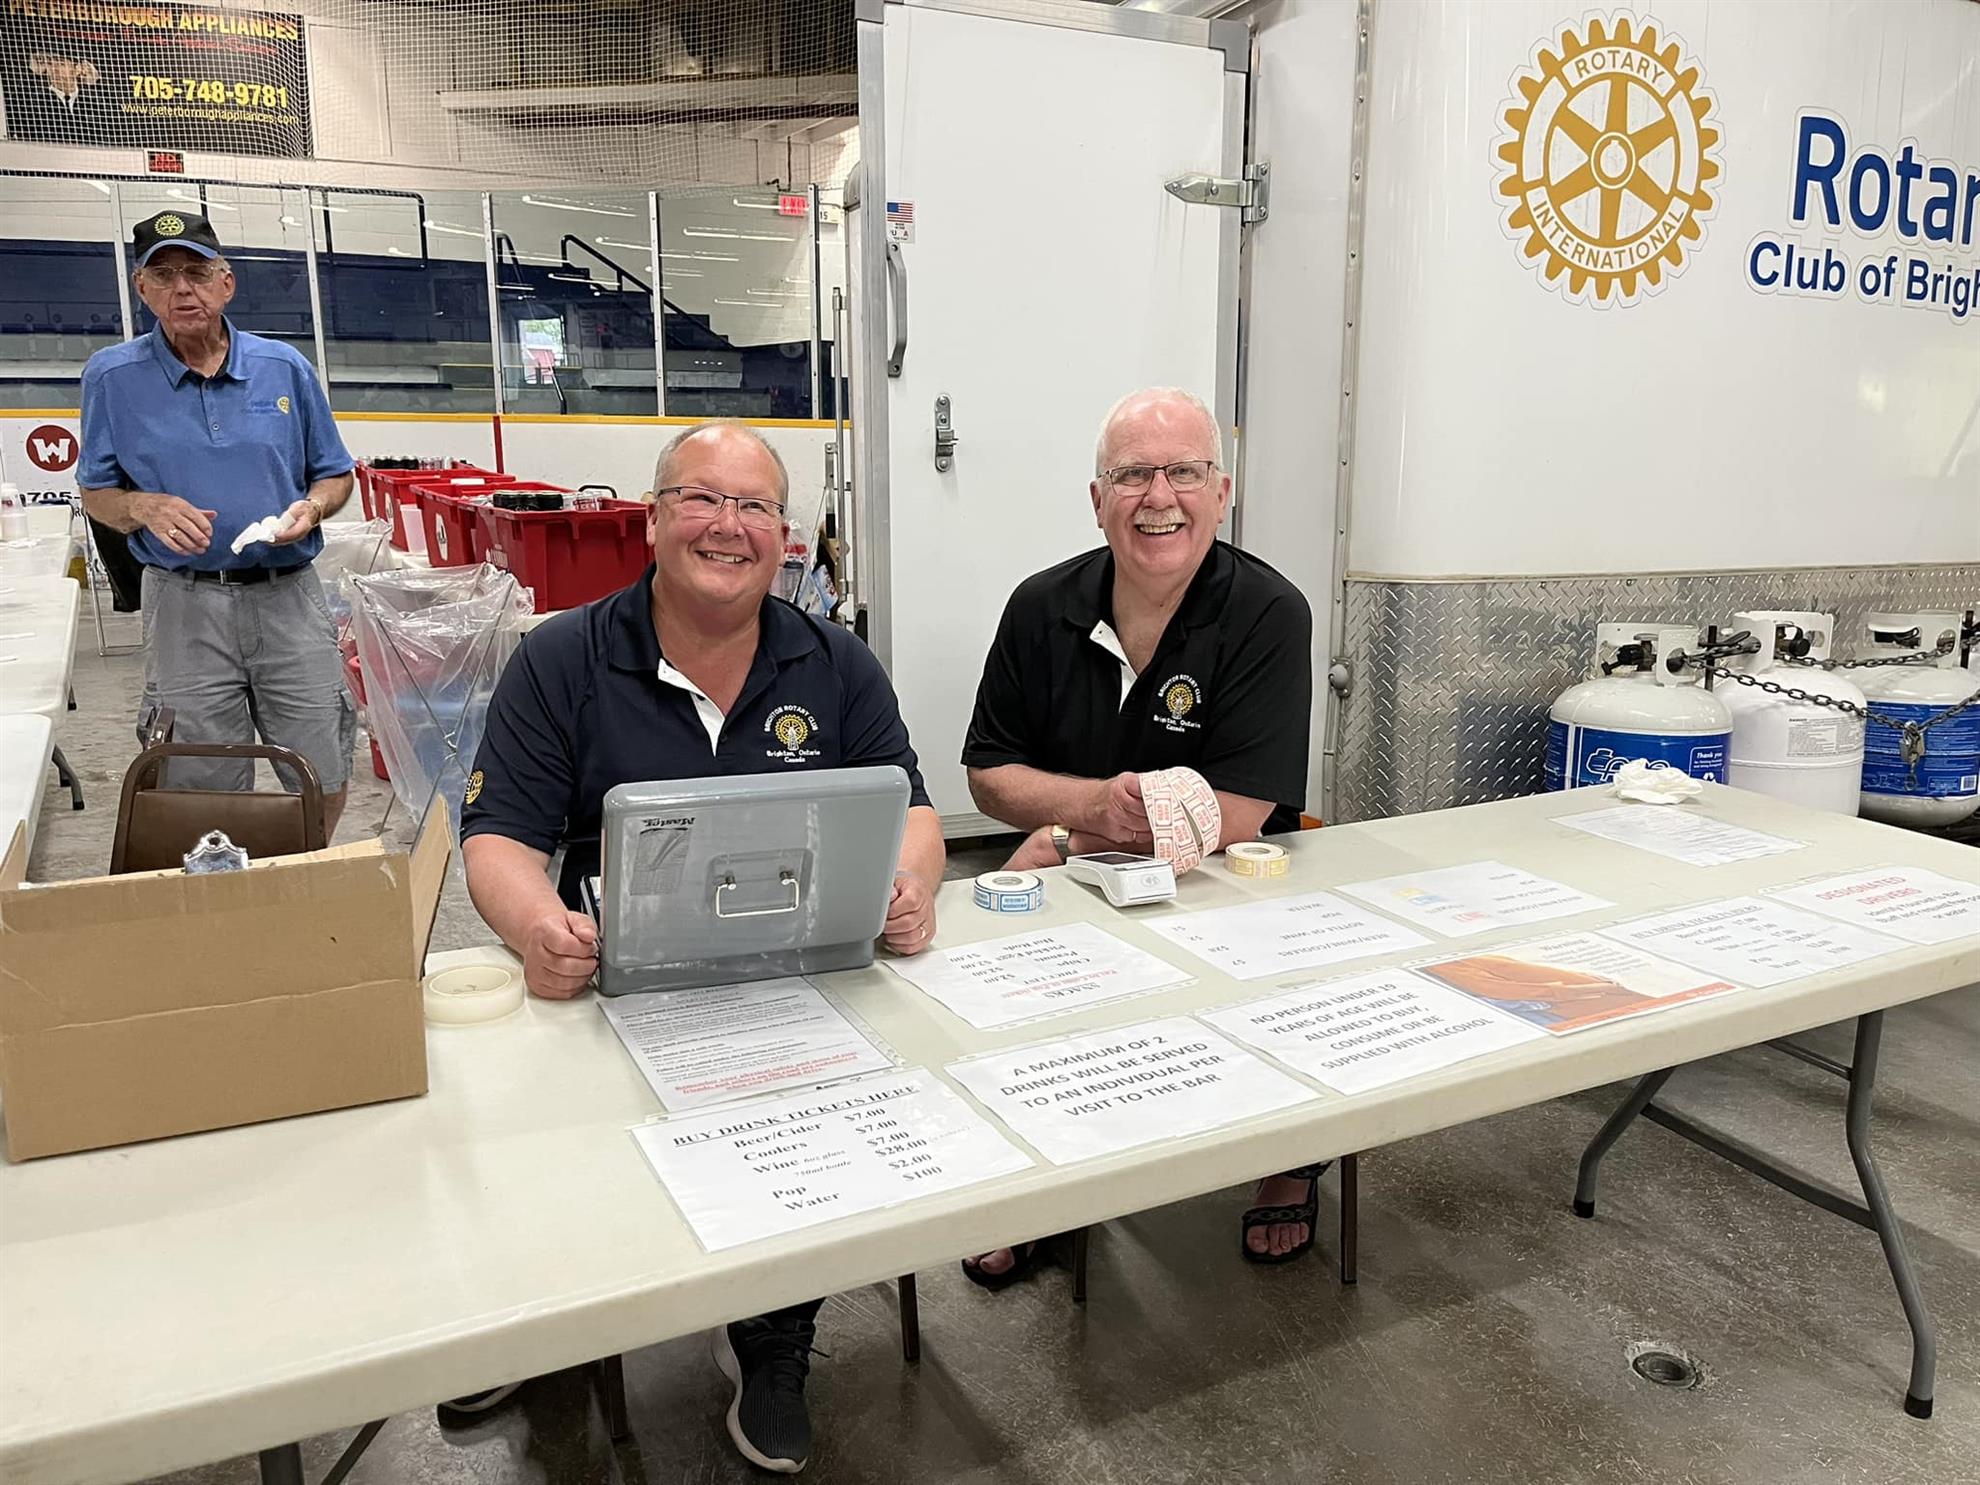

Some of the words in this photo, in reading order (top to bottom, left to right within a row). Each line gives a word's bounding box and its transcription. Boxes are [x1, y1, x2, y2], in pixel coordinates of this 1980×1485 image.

[179, 10, 299, 40] APPLIANCES
[1575, 50, 1665, 86] ROTARY
[129, 75, 289, 109] 705-748-9781
[1531, 200, 1685, 271] INTERNATIONAL
[1750, 241, 1847, 294] Club
[1860, 255, 1899, 299] of
[32, 438, 71, 463] W
[783, 705, 810, 717] ROTARY
[1041, 981, 1102, 999] SNACKS
[1250, 1013, 1275, 1026] NO
[1274, 998, 1332, 1020] PERSON
[1330, 987, 1383, 1008] UNDER
[1381, 982, 1398, 993] 19
[1268, 1018, 1315, 1036] YEARS
[1316, 1012, 1335, 1024] OF
[1336, 1004, 1367, 1020] AGE
[1366, 996, 1400, 1013] WILL
[1398, 991, 1420, 1003] BE
[1303, 1019, 1373, 1044] ALLOWED
[1373, 1012, 1393, 1024] TO
[1394, 1003, 1430, 1021] BUY,
[1329, 1028, 1400, 1052] CONSUME
[1401, 1020, 1423, 1033] OR
[1423, 1014, 1446, 1027] BE
[1013, 1062, 1029, 1077] A
[1029, 1045, 1127, 1073] MAXIMUM
[1127, 1037, 1152, 1051] OF
[1153, 1035, 1169, 1045] 2
[1321, 1046, 1391, 1071] SUPPLIED
[1390, 1033, 1431, 1052] WITH
[1430, 1016, 1495, 1041] ALCOHOL
[1000, 1074, 1071, 1097] DRINKS
[1071, 1061, 1116, 1081] WILL
[1118, 1056, 1142, 1070] BE
[1142, 1041, 1209, 1064] SERVED
[1022, 1095, 1050, 1110] TO
[1054, 1086, 1084, 1102] AN
[1084, 1064, 1188, 1094] INDIVIDUAL
[1189, 1053, 1226, 1071] PER
[1064, 1098, 1113, 1117] VISIT
[1116, 1090, 1143, 1105] TO
[1143, 1081, 1183, 1100] THE
[1184, 1071, 1223, 1090] BAR
[673, 1129, 713, 1147] BUY
[718, 1114, 782, 1136] DRINK
[783, 1097, 866, 1121] TICKETS
[868, 1085, 920, 1103] HERE
[733, 1121, 823, 1149] Beer/Cider
[844, 1107, 886, 1122] $7.00
[743, 1141, 808, 1161] Coolers
[855, 1118, 898, 1135] $7.00
[752, 1159, 800, 1174] Wine
[866, 1130, 910, 1147] $7.00
[875, 1138, 928, 1157] $28.00
[772, 1186, 807, 1199] Pop
[888, 1153, 933, 1170] $2.00
[784, 1193, 841, 1211] Water
